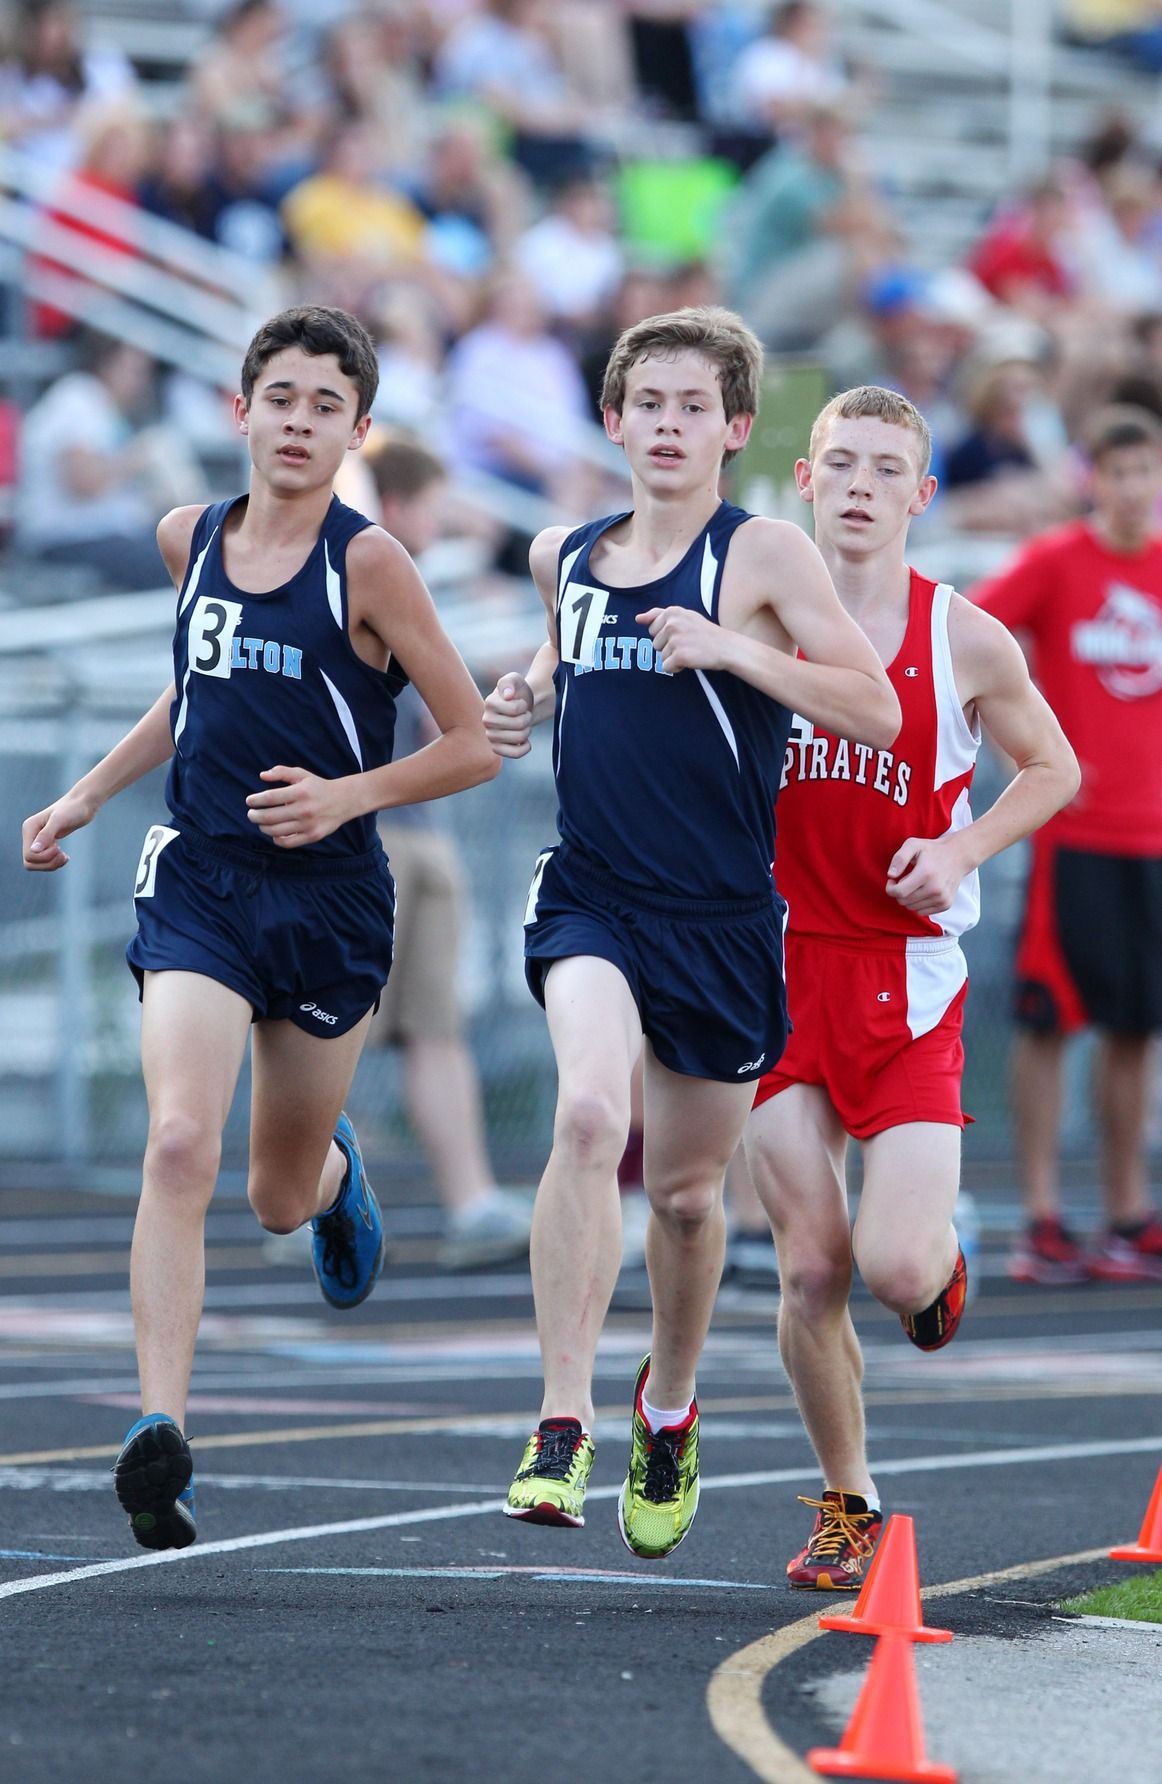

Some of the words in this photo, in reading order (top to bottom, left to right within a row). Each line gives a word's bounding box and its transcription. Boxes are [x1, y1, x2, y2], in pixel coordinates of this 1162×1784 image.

[196, 602, 228, 672] 3
[231, 636, 303, 680] LTON
[572, 592, 594, 660] 1
[574, 636, 674, 677] ILTO
[779, 738, 912, 807] PIRATES
[135, 829, 164, 894] 3
[311, 1008, 339, 1025] asics
